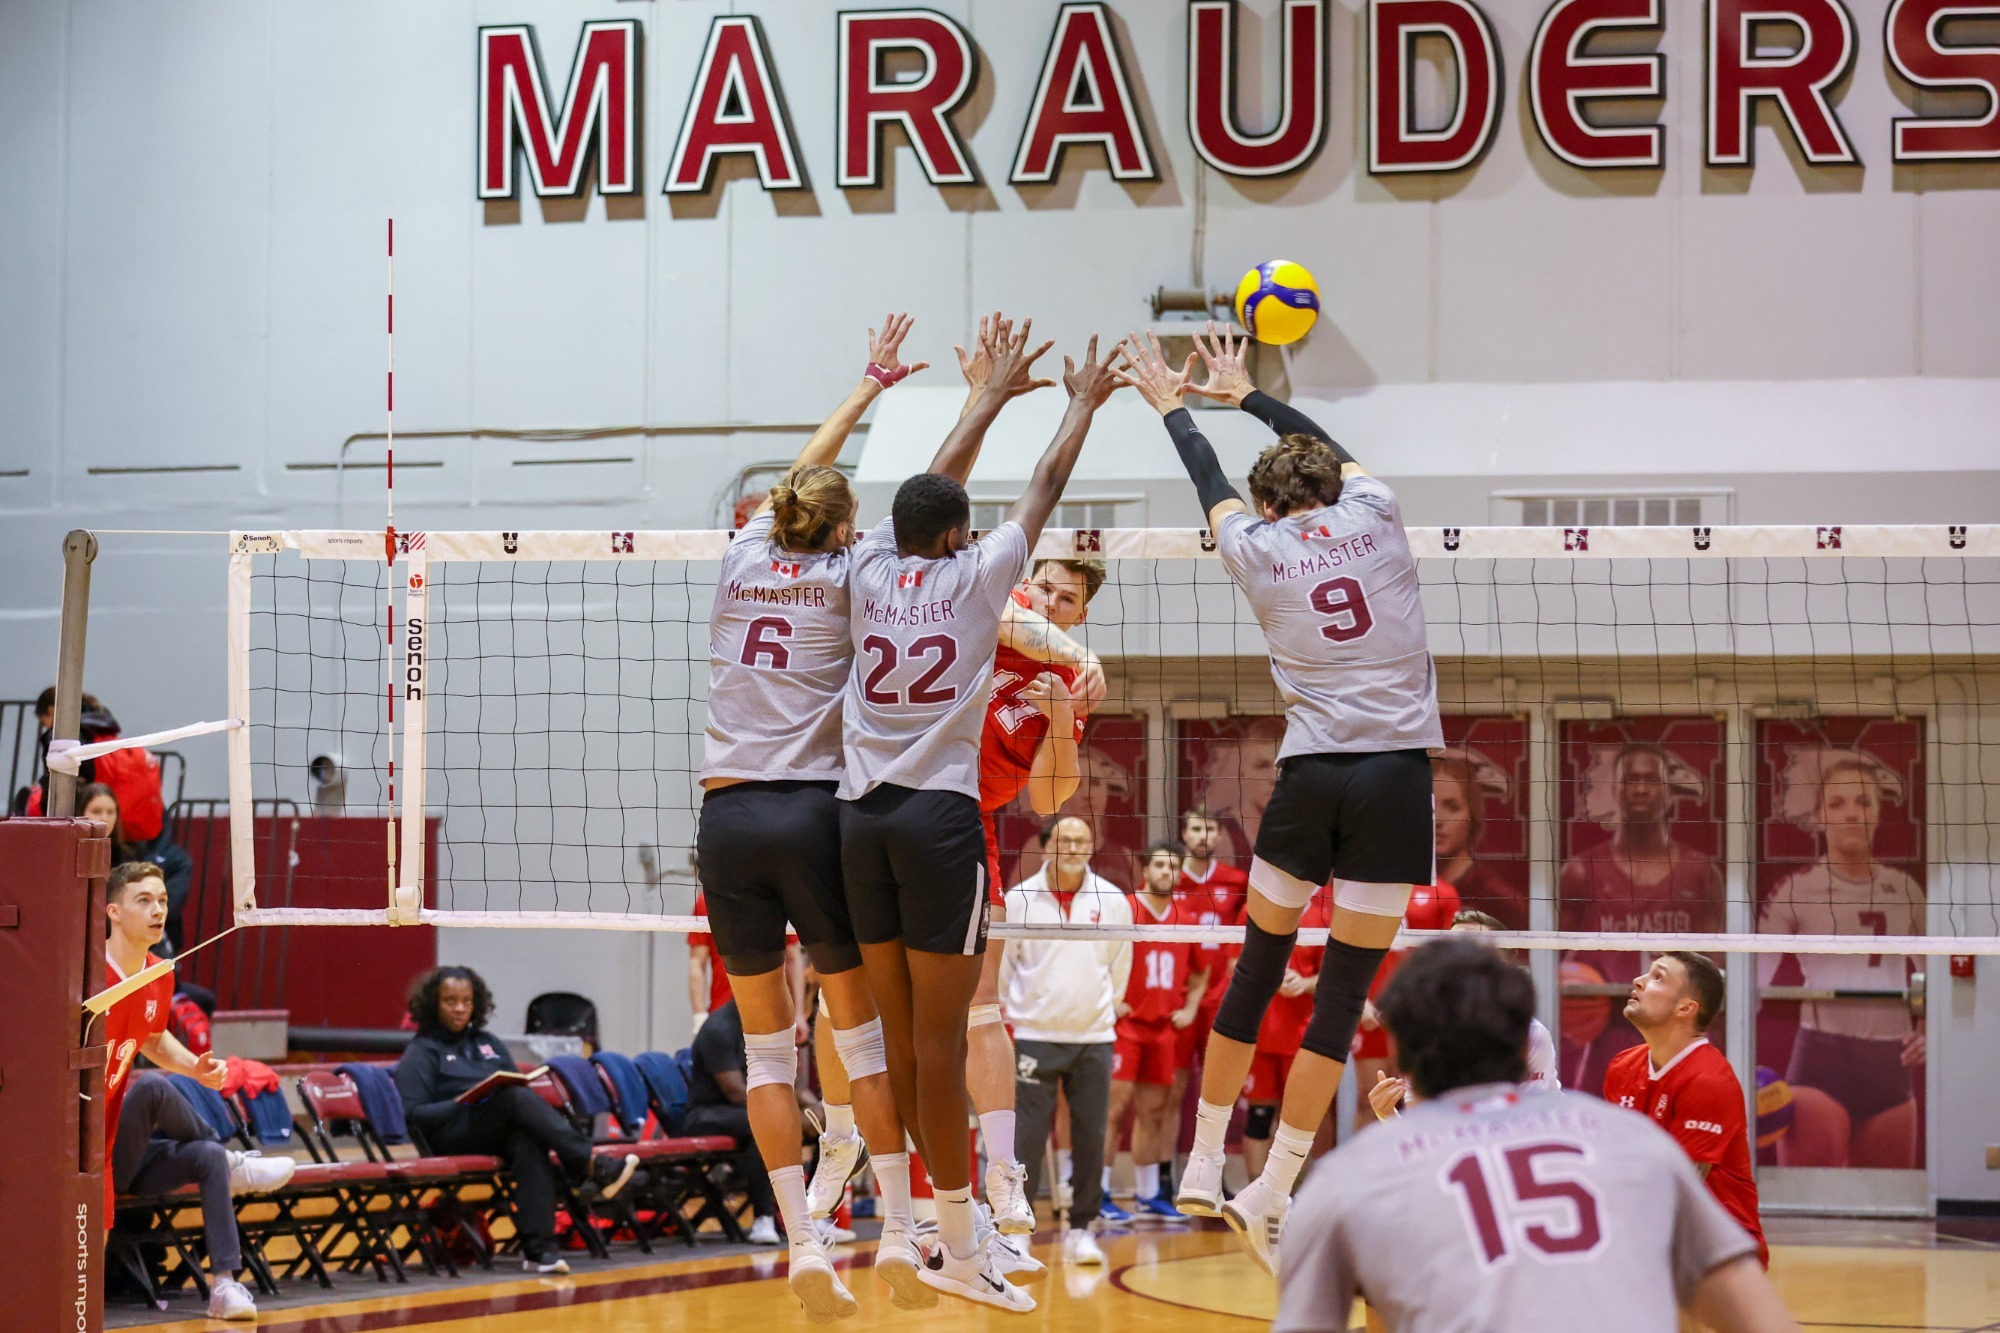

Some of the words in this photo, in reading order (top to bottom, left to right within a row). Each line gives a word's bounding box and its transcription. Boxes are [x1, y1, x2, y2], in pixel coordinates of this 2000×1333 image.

[477, 0, 2000, 199] MARAUDERS
[1272, 534, 1378, 583] McMASTER
[727, 580, 826, 608] McMASTER
[863, 598, 955, 627] McMASTER
[1307, 575, 1376, 644] 9
[406, 618, 423, 701] Senoh
[740, 615, 794, 670] 6
[862, 632, 959, 705] 22
[1145, 950, 1175, 990] 18
[1445, 1140, 1604, 1267] 15
[76, 1203, 88, 1271] sports
[75, 1274, 87, 1333] impo
